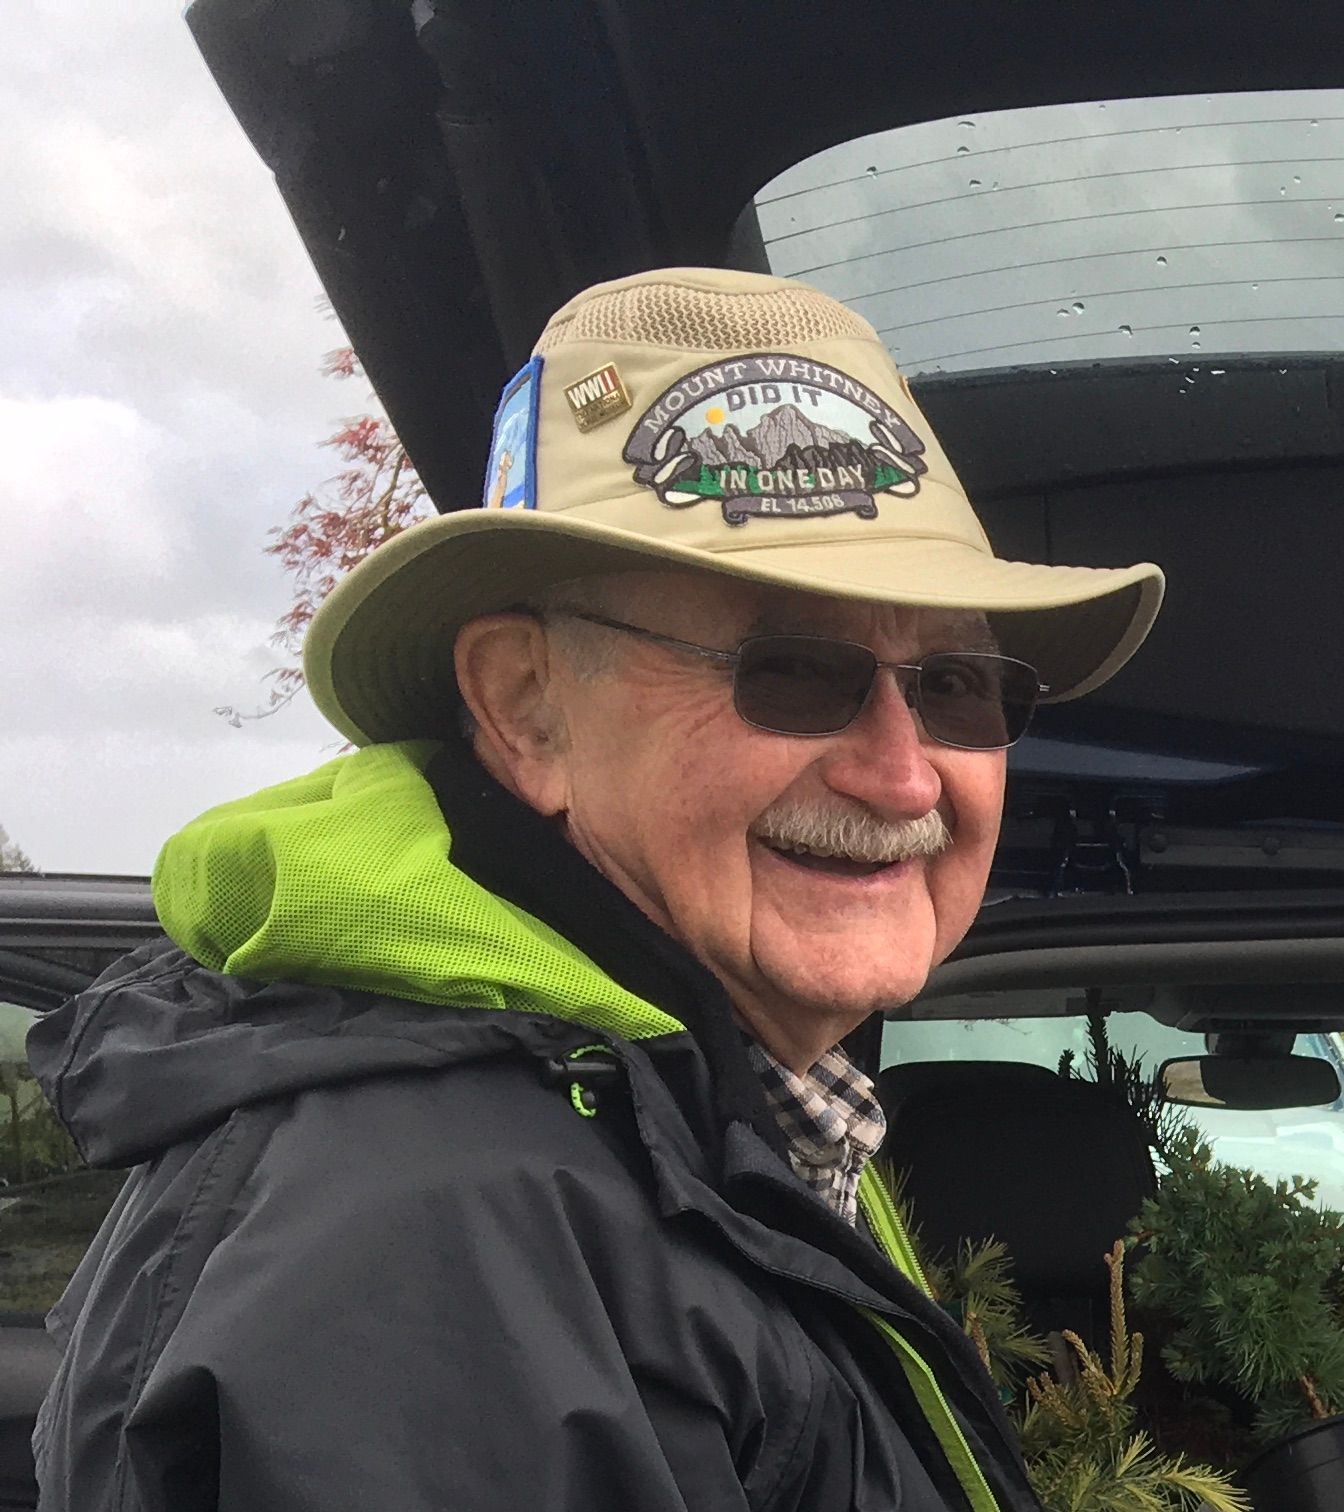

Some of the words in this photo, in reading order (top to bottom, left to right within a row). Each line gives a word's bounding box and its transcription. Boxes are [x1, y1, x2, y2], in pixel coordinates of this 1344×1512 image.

[568, 370, 615, 409] WWII
[644, 362, 746, 434] MOUNT
[755, 359, 900, 428] WHITNEY
[726, 385, 781, 411] DID
[792, 385, 822, 406] IT
[720, 470, 747, 490] IN
[757, 469, 815, 492] ONE
[817, 464, 865, 490] DAY
[760, 497, 782, 513] EL
